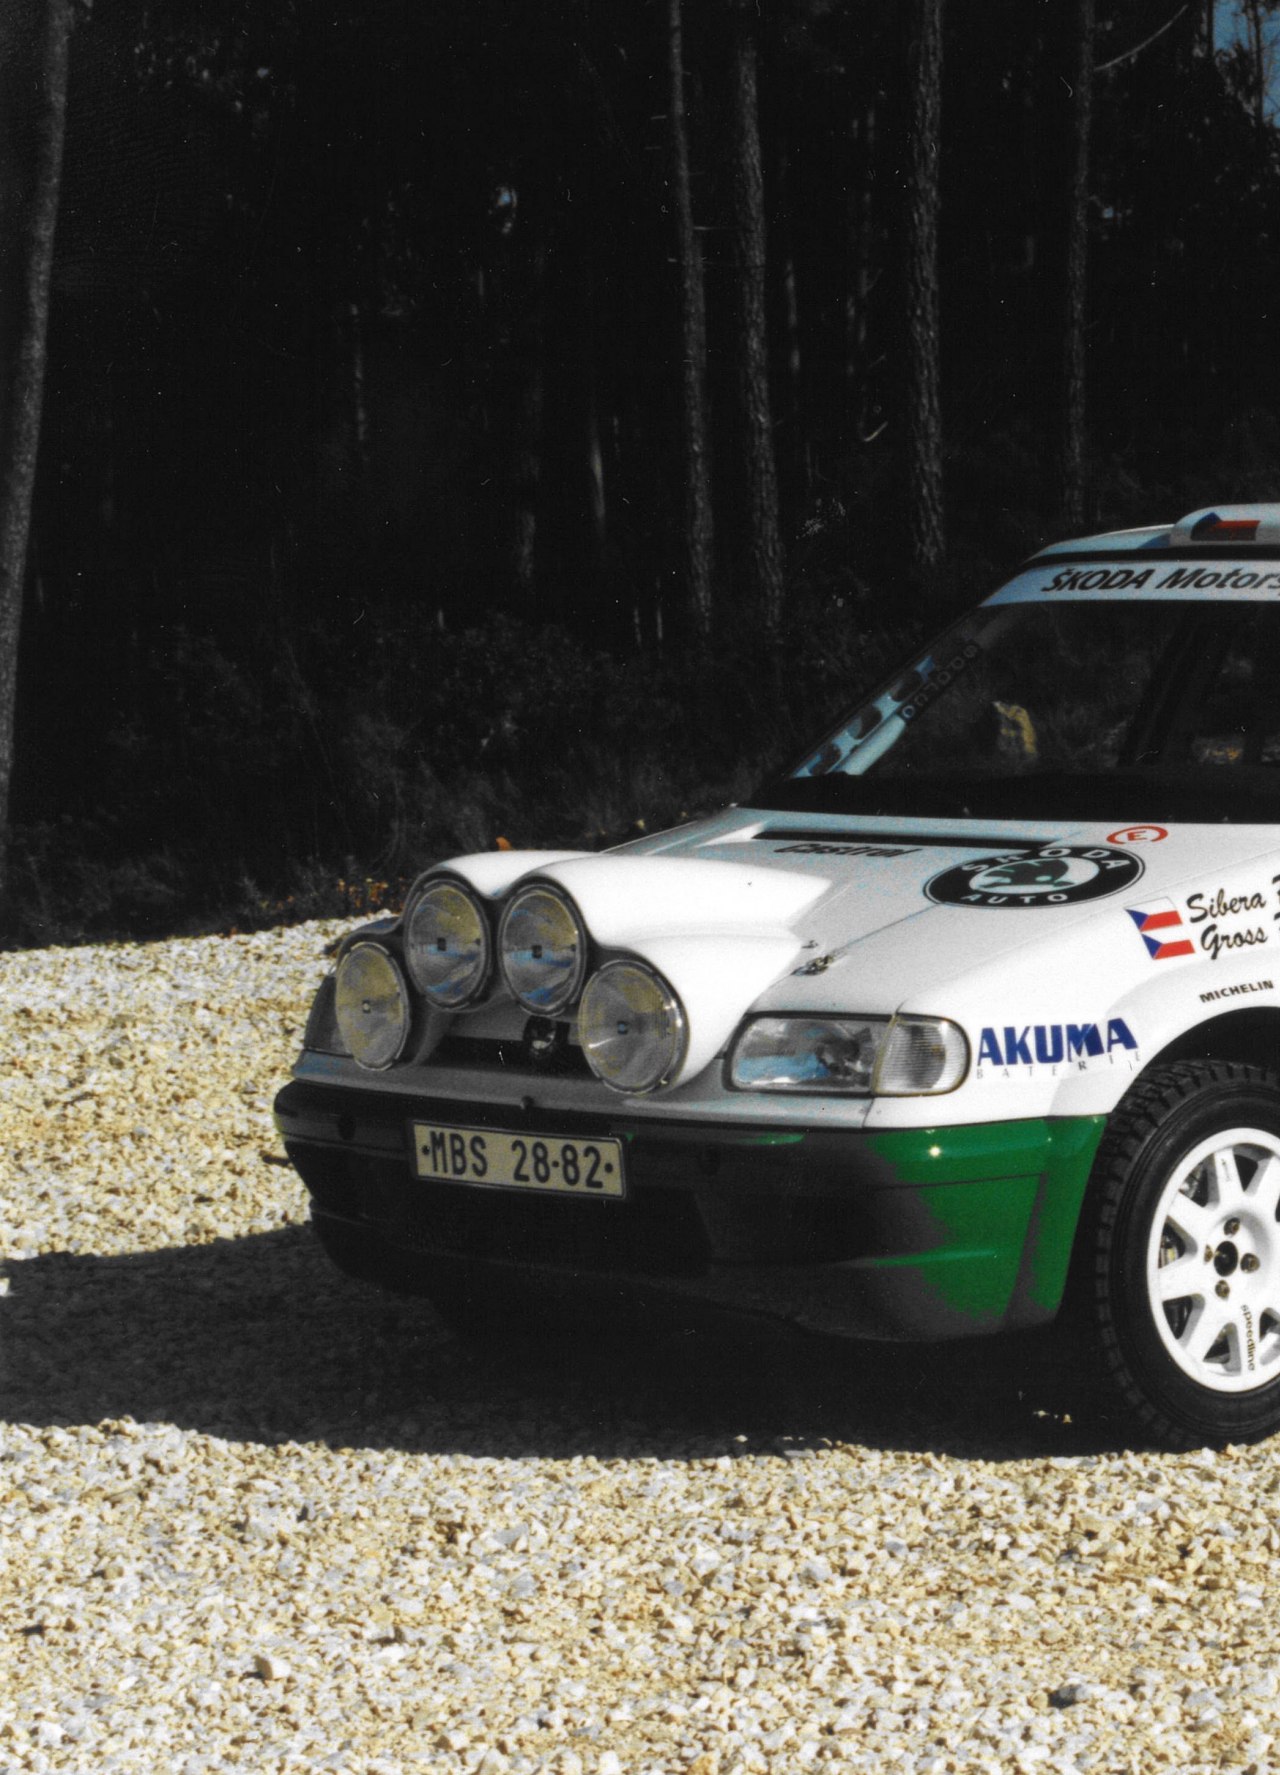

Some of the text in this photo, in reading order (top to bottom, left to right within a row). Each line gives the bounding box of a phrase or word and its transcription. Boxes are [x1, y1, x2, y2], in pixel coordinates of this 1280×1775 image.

[1041, 566, 1155, 592] ŠKODA
[774, 843, 923, 857] Castrol
[960, 892, 1068, 904] AUTO
[1186, 888, 1267, 923] Sibera
[1201, 924, 1268, 960] Gross
[1199, 980, 1275, 1003] MICHELIN
[977, 1018, 1138, 1066] AKUMA
[430, 1130, 488, 1177] MBS
[1240, 1303, 1256, 1372] speedline
